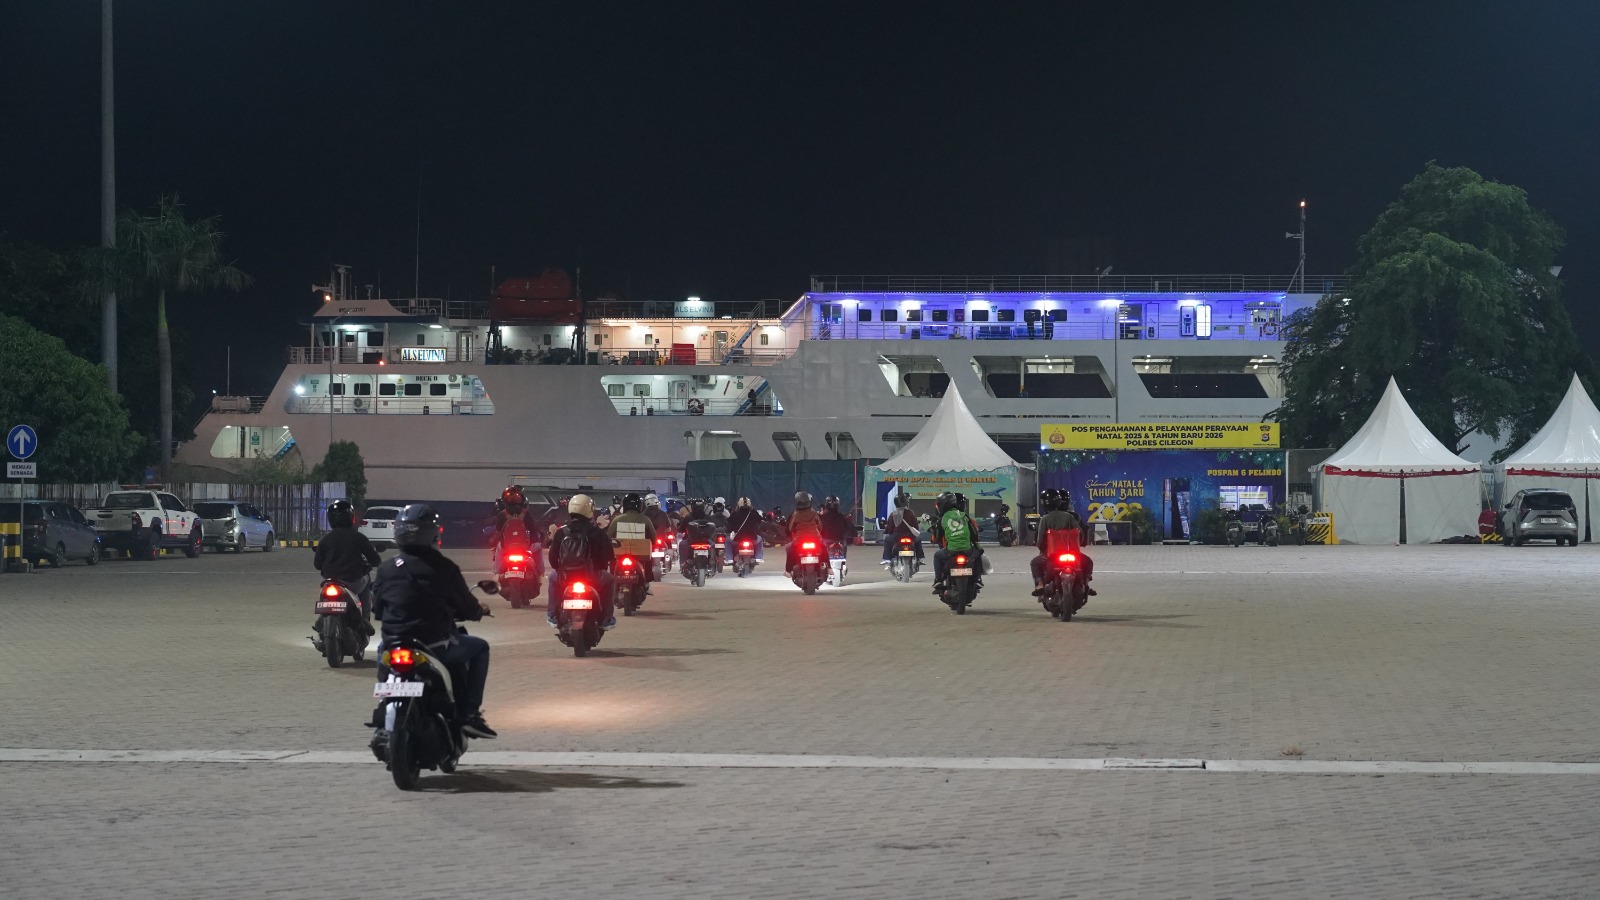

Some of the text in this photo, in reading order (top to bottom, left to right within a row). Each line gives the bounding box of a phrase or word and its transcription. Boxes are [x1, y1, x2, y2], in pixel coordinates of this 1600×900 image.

[1112, 480, 1136, 488] NATAL
[1137, 480, 1144, 488] &
[1088, 488, 1144, 500] TAHUN BARU
